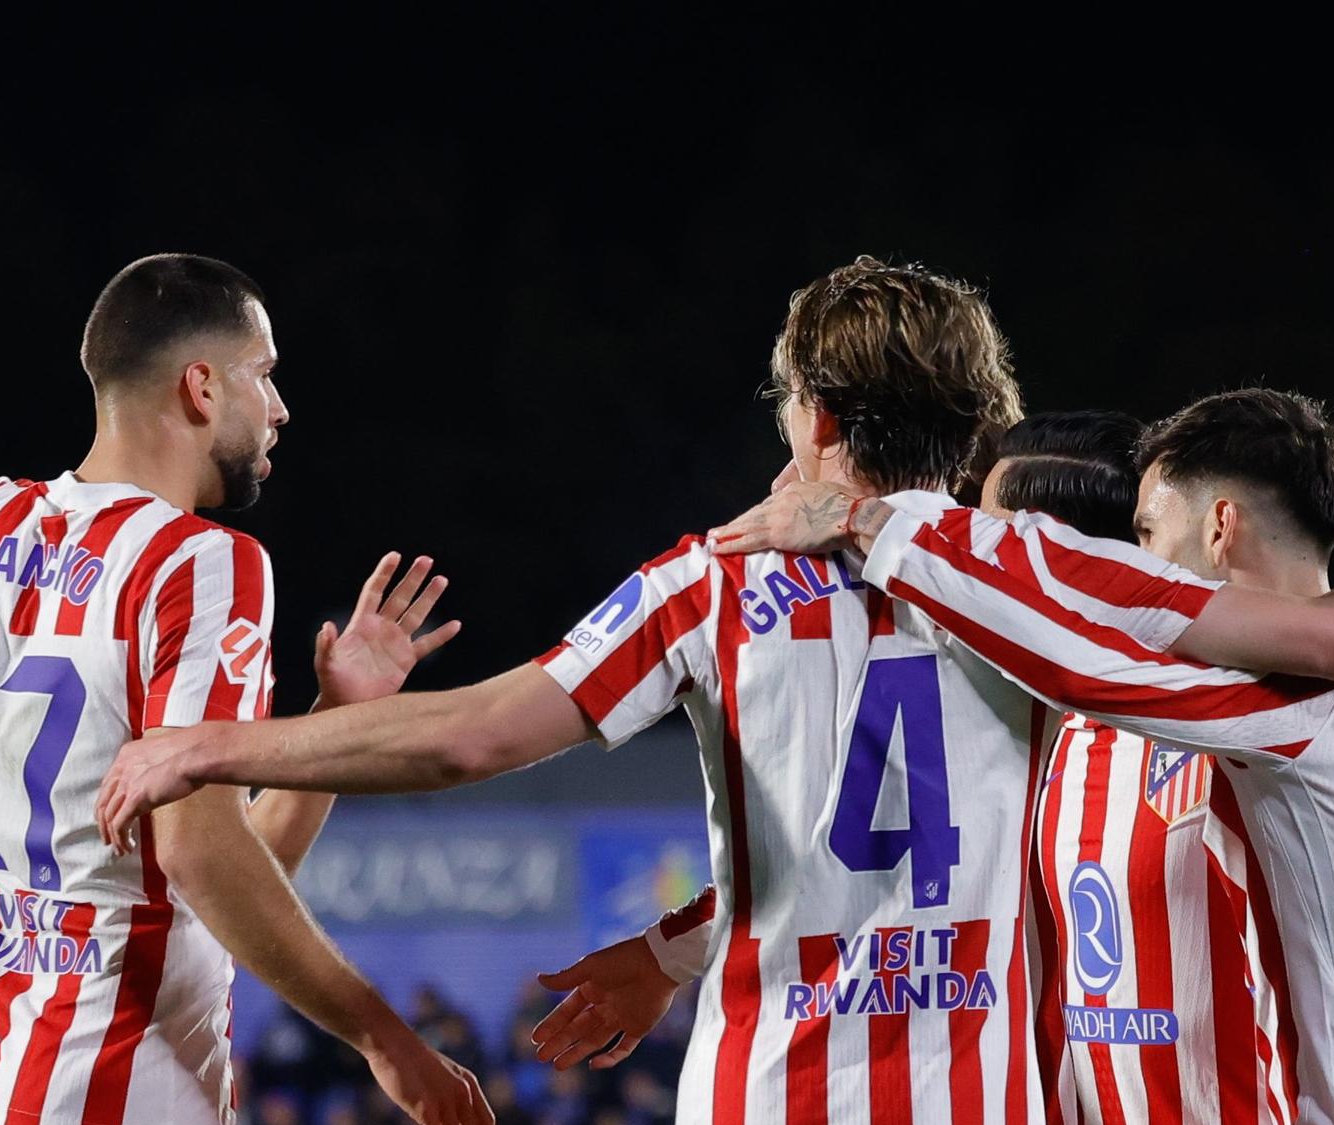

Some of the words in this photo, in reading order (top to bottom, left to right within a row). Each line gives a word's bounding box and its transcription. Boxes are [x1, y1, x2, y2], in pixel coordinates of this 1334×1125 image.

[740, 551, 866, 635] GALL
[829, 654, 960, 910] 4
[833, 928, 959, 971] VISIT
[784, 970, 998, 1021] RWANDA
[1122, 1013, 1172, 1040] AIR
